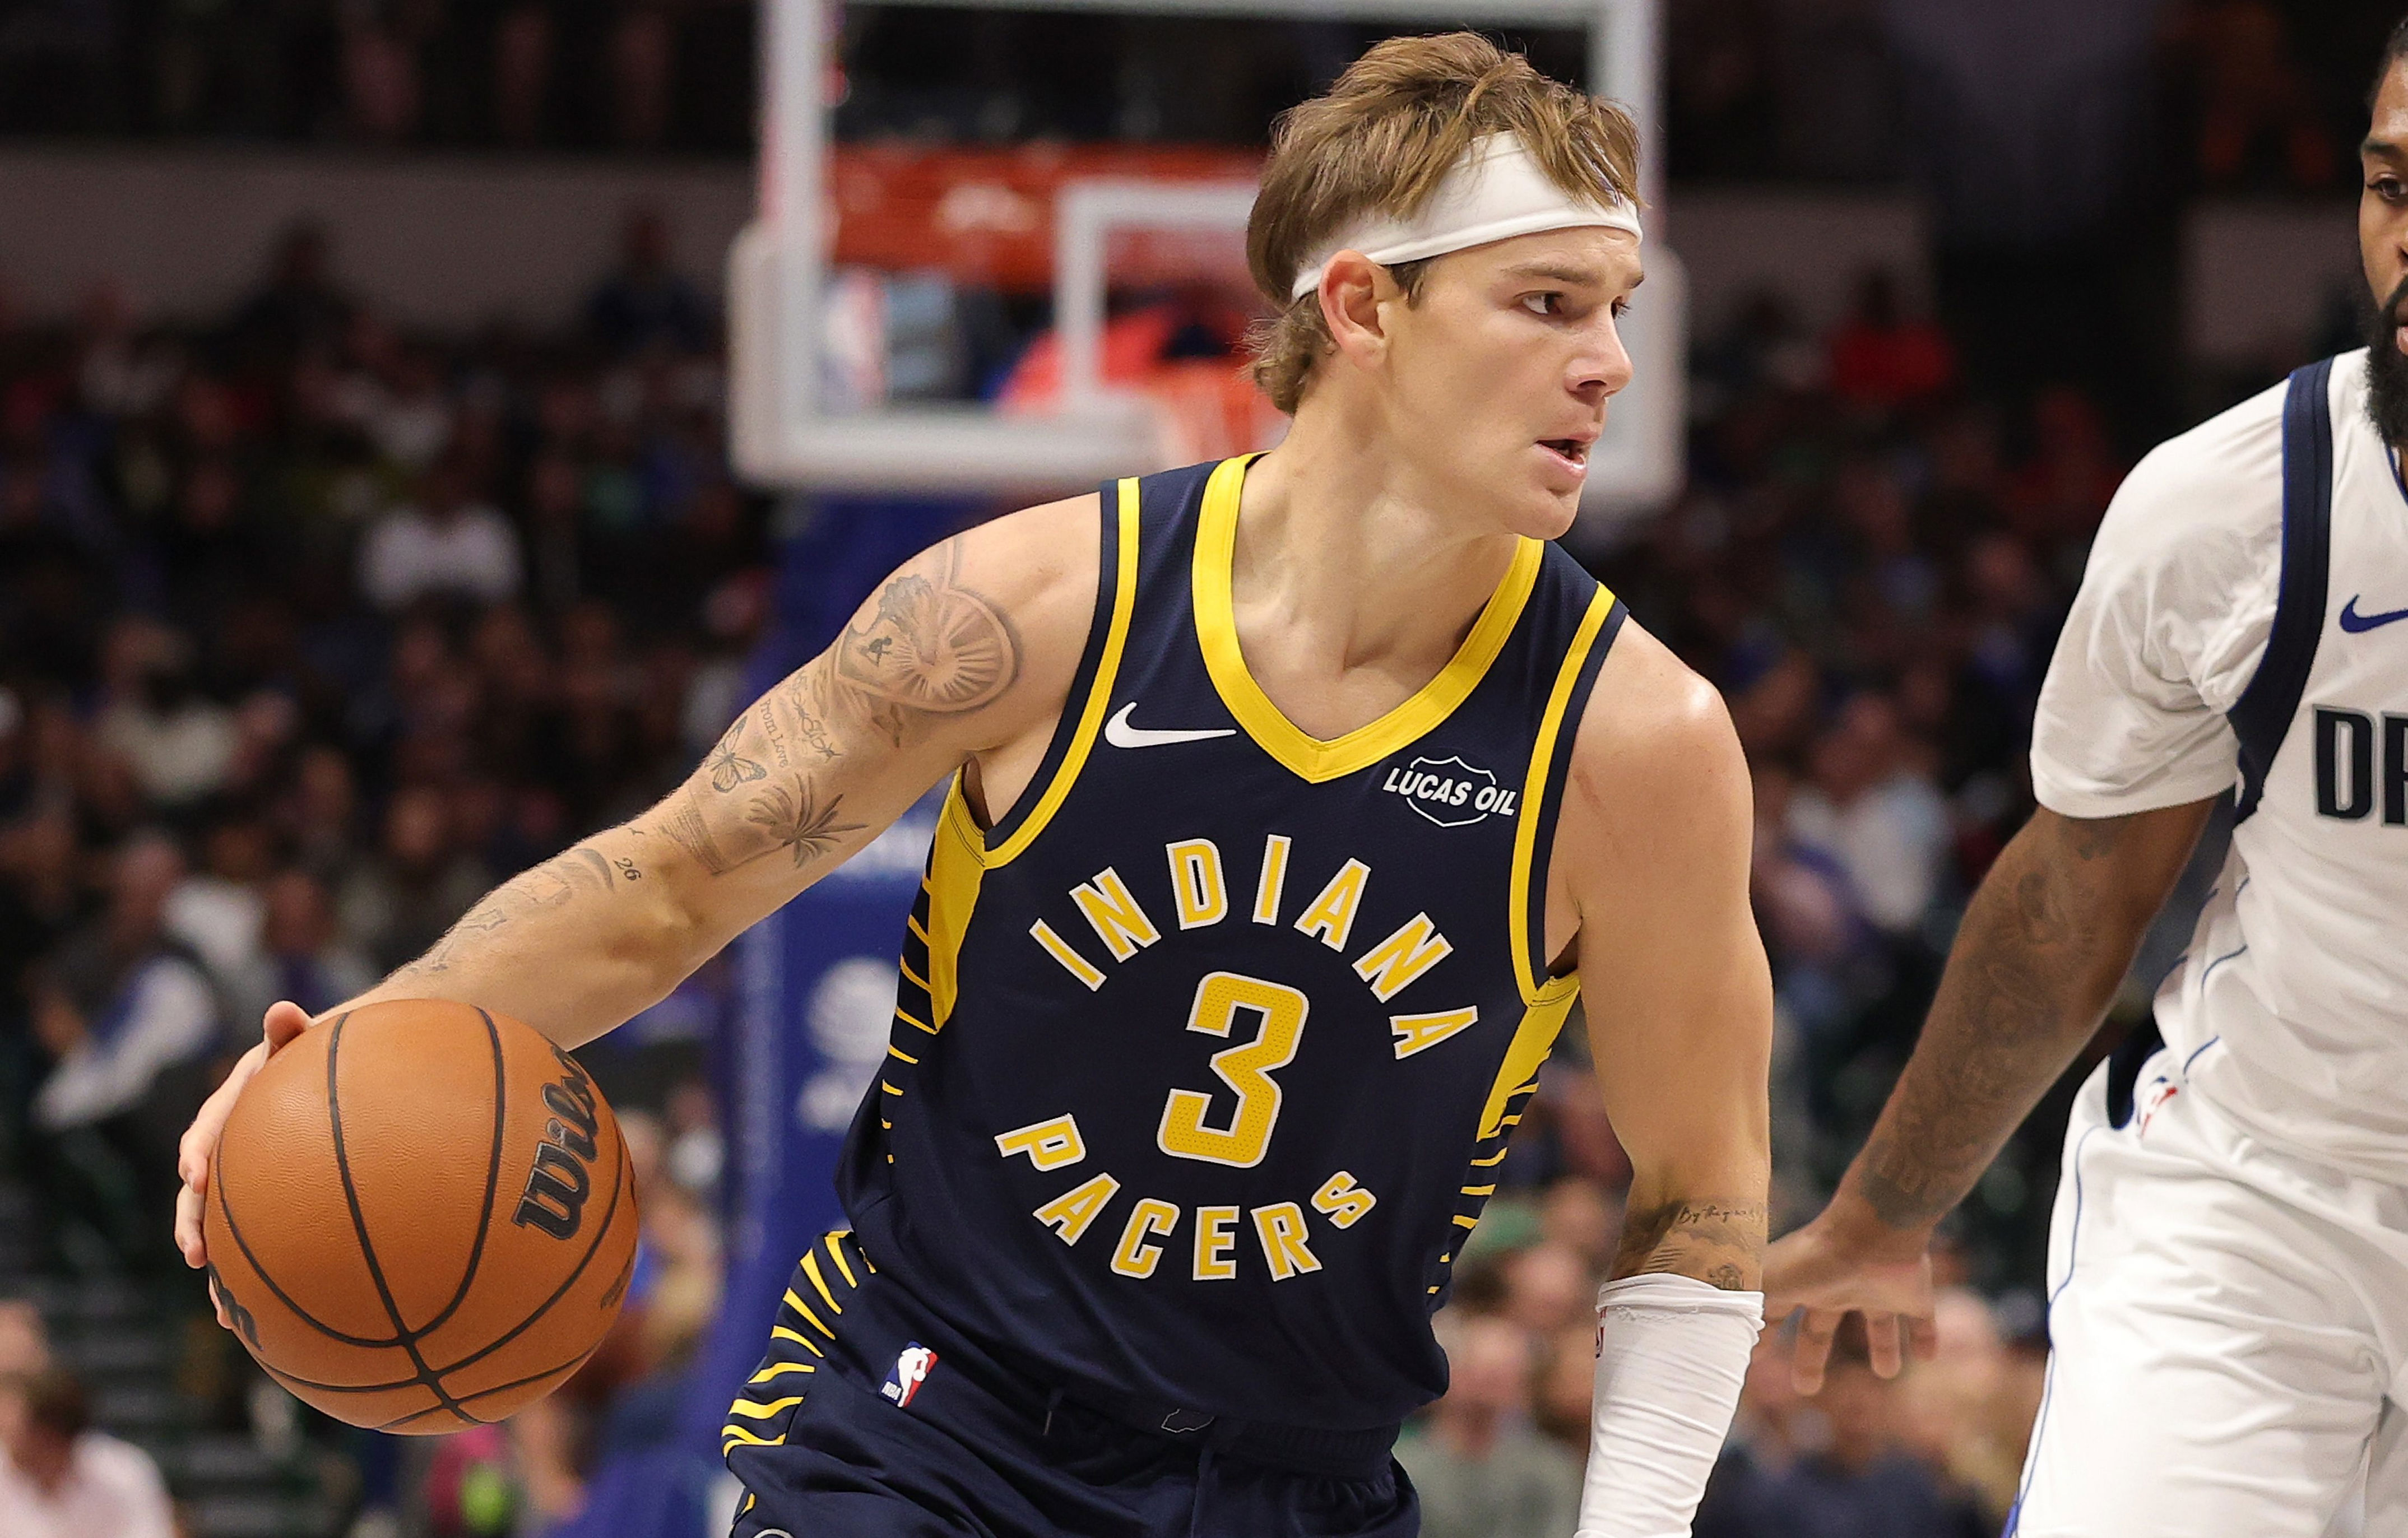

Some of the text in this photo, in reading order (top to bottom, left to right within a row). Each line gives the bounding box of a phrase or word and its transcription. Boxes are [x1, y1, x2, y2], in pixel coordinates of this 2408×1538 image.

[1382, 767, 1516, 816] LUCAS OIL
[613, 857, 641, 881] 26
[1029, 834, 1478, 1060] INDIANA
[1157, 971, 1310, 1169] 3
[994, 1113, 1377, 1282] PACERS
[881, 1381, 902, 1400] NBA
